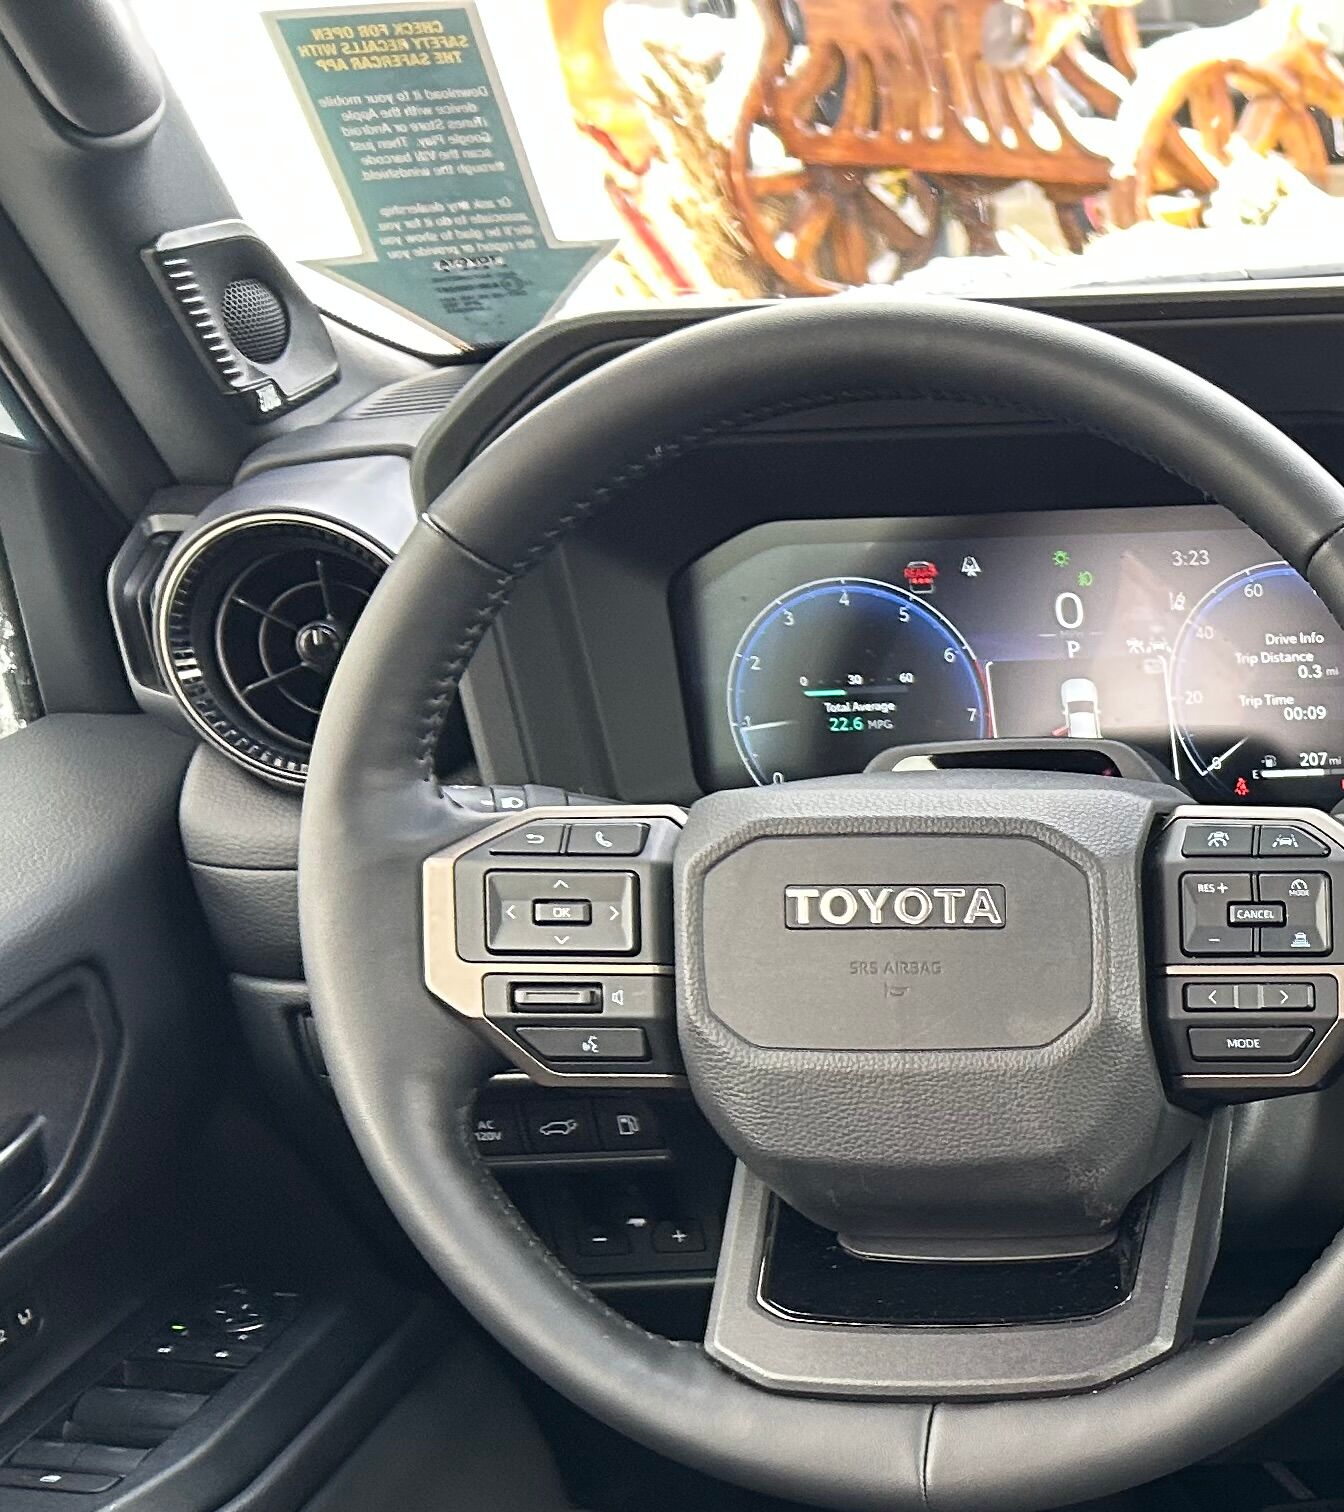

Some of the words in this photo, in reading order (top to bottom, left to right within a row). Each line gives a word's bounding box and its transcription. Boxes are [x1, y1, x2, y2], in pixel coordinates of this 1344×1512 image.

[1172, 550, 1210, 566] 3:23
[1244, 584, 1264, 598] 60
[838, 592, 850, 606] 4
[899, 608, 910, 623] 5
[1055, 592, 1084, 629] 0
[784, 611, 795, 626] 3
[1196, 626, 1214, 639] 40
[1265, 633, 1298, 645] Drive
[1300, 632, 1324, 643] Info
[944, 649, 956, 663] 6
[1067, 640, 1081, 658] P
[750, 656, 761, 670] 2
[1235, 652, 1258, 664] Trip
[1261, 651, 1314, 662] Distance
[899, 672, 914, 684] 60
[1298, 665, 1322, 678] 0.3
[1326, 667, 1339, 676] mi
[847, 674, 862, 686] 30
[1184, 690, 1203, 705] 20
[1240, 695, 1262, 707] Trip
[1264, 693, 1294, 705] Time
[823, 702, 851, 713] Total
[853, 702, 896, 714] Average
[967, 708, 977, 722] 7
[1284, 706, 1327, 720] 00:09
[829, 717, 864, 731] 22.6
[868, 719, 893, 729] MPG
[1300, 753, 1327, 766] 207
[1329, 757, 1342, 766] mi
[1253, 770, 1259, 780] E
[1289, 888, 1309, 897] MODE
[552, 906, 572, 918] OK
[785, 887, 1002, 925] TOYOTA
[1236, 908, 1275, 920] CANCEL
[850, 961, 878, 975] SRS
[883, 961, 942, 975] AIRBAG
[1226, 1038, 1261, 1049] MODE
[478, 1120, 495, 1130] AC
[473, 1131, 501, 1142] 120V
